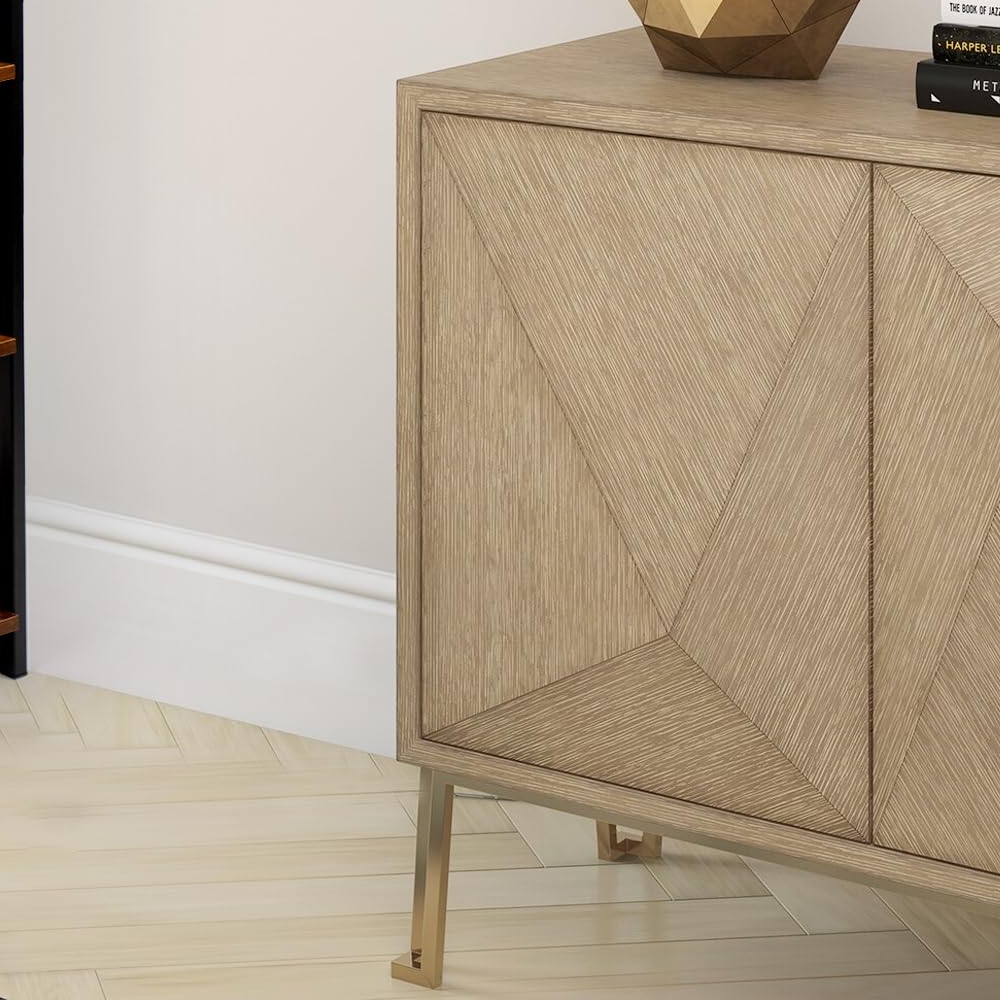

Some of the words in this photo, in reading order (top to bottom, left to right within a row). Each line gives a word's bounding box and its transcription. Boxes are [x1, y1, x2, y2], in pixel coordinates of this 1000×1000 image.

[949, 2, 960, 13] THE
[962, 3, 977, 14] BOOK
[979, 5, 987, 15] OF
[945, 40, 988, 53] HARPER
